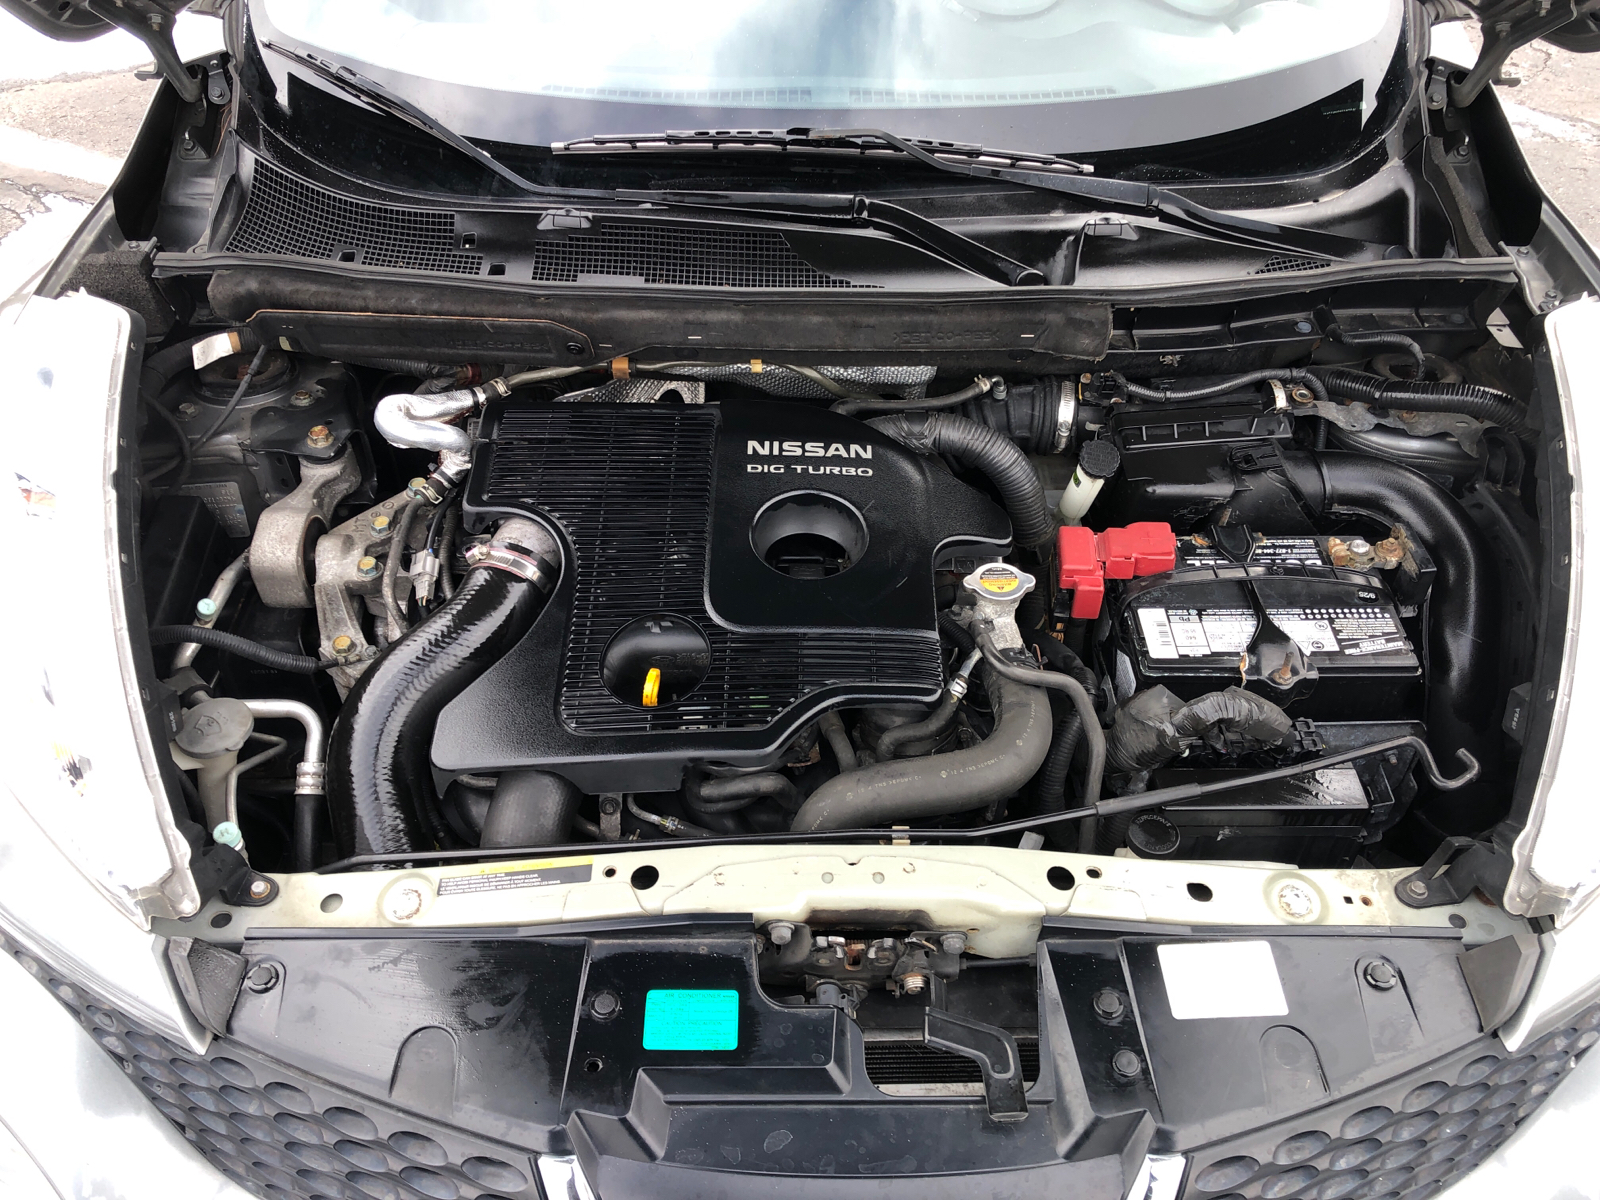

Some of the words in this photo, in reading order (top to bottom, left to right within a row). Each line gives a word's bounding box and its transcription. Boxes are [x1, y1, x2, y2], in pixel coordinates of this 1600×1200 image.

[747, 440, 872, 459] NISSAN
[747, 464, 784, 473] DIG
[791, 466, 873, 476] TURBO
